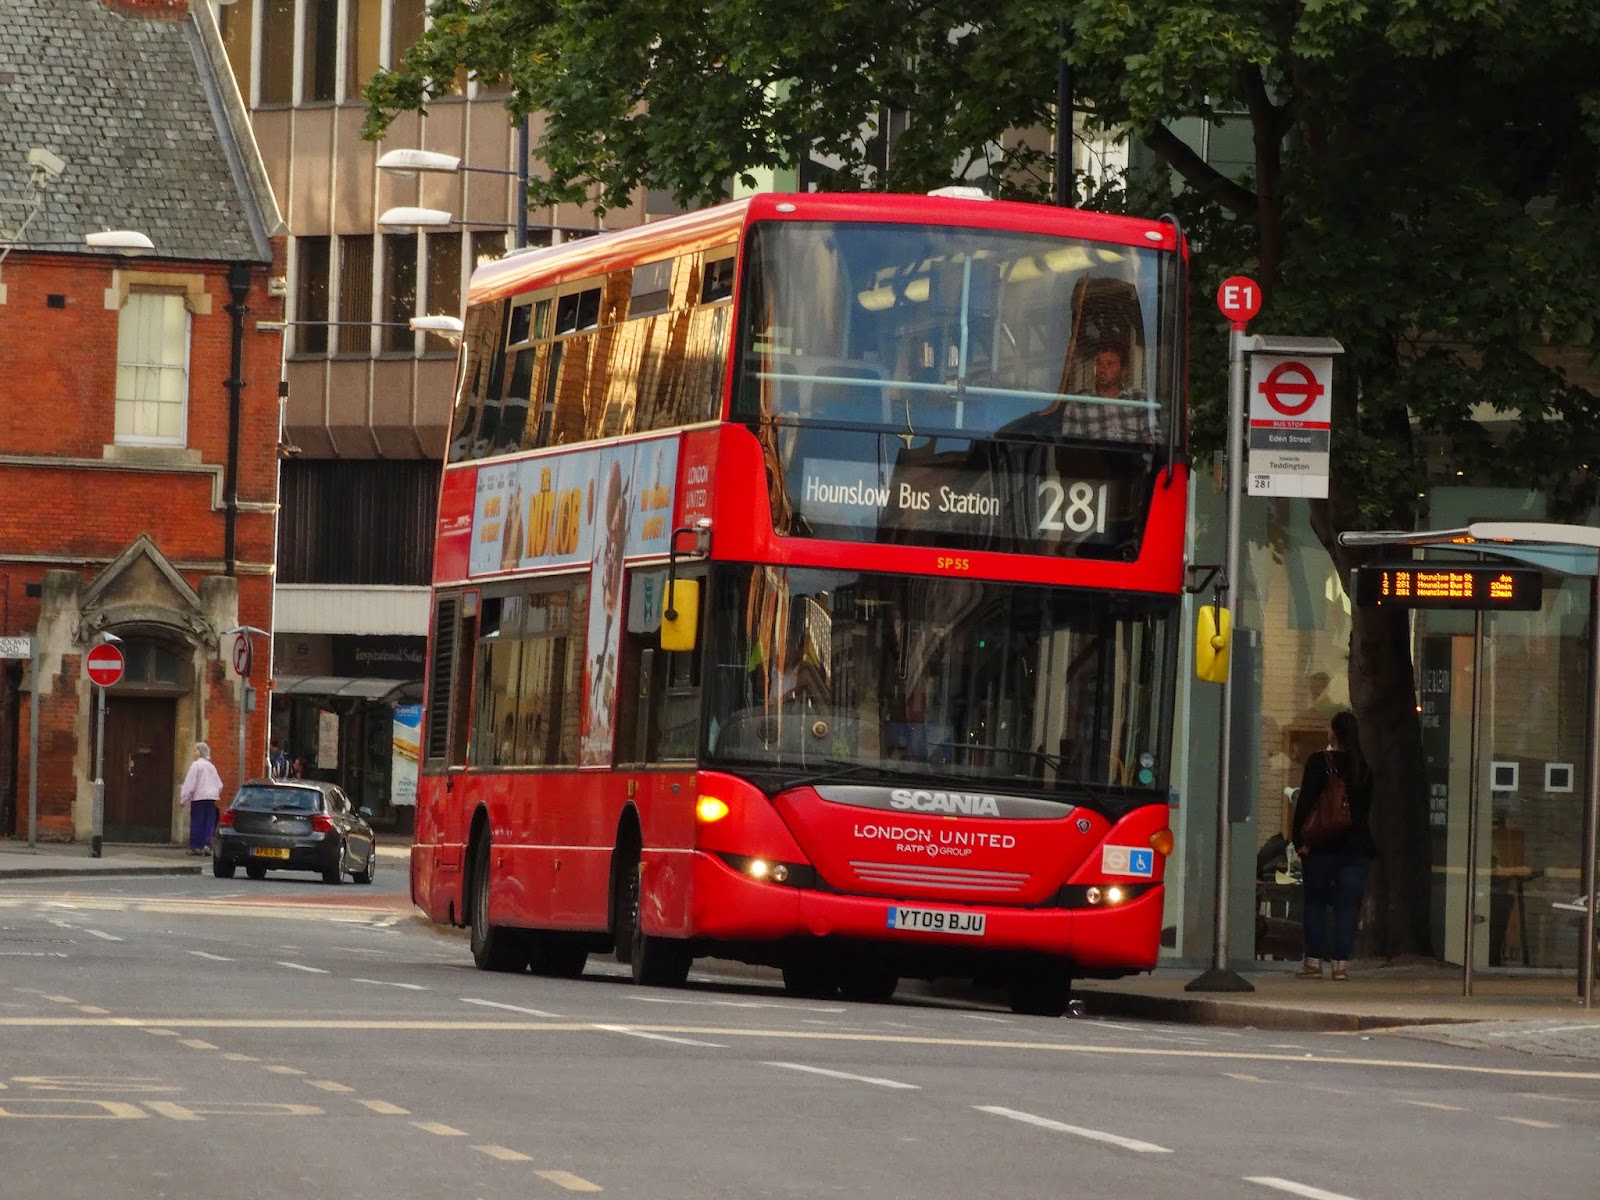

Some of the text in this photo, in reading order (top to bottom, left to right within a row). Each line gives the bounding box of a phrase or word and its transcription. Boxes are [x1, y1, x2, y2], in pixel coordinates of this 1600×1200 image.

[1224, 286, 1252, 309] E1
[1268, 434, 1311, 444] Eden Street
[688, 465, 709, 485] LONDON
[1269, 462, 1310, 470] Teddington
[1254, 480, 1270, 489] 281
[686, 489, 707, 509] UNITED
[806, 476, 1000, 517] Hounslow Bus Station
[1037, 479, 1108, 535] 281
[526, 487, 582, 559] NUT JOB
[937, 556, 970, 571] SP55
[1417, 572, 1449, 581] Hounslow
[1450, 572, 1463, 582] Bus
[1464, 573, 1473, 582] St
[1500, 574, 1513, 583] due
[1417, 580, 1449, 589] Hounslow
[1450, 581, 1463, 589] Bus
[1450, 589, 1463, 597] Bus
[890, 789, 1000, 817] SCANIA
[854, 824, 1016, 849] LONDON UNITED
[896, 843, 972, 857] RATP GROUP
[900, 909, 983, 931] YT09 BJU
